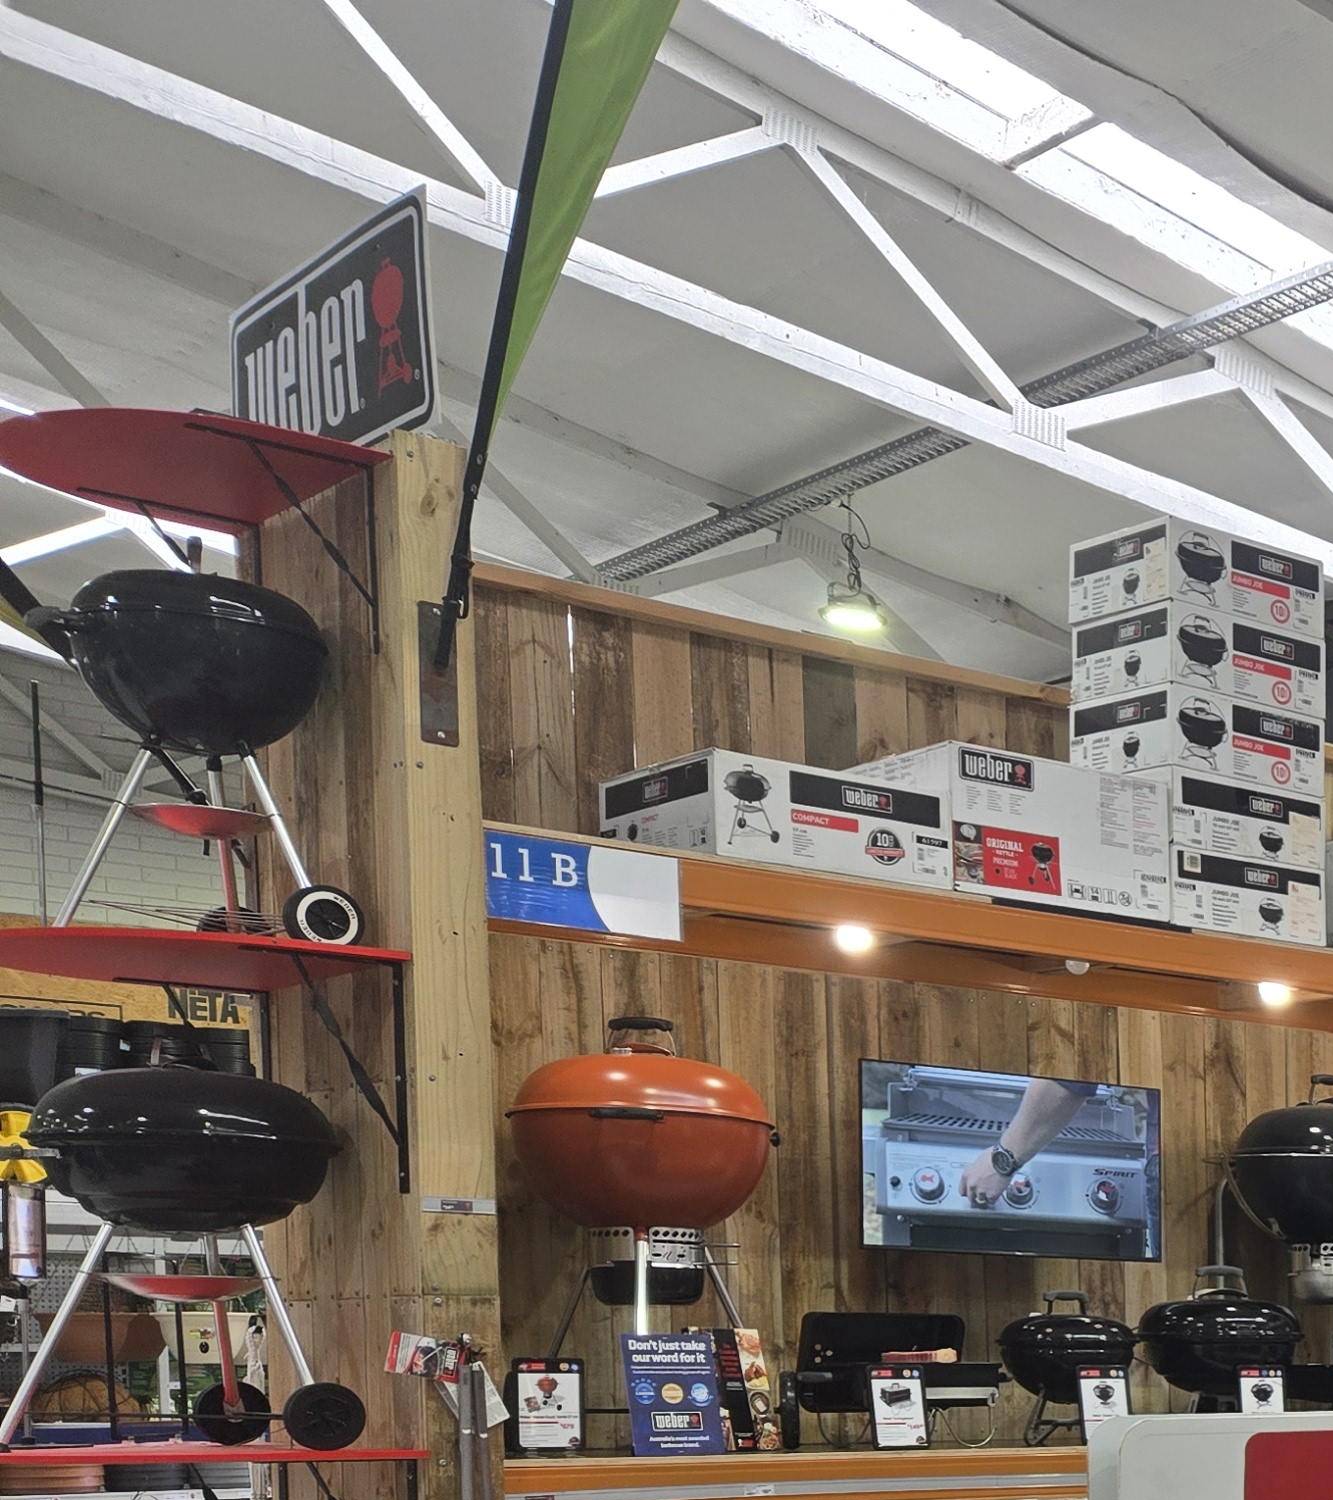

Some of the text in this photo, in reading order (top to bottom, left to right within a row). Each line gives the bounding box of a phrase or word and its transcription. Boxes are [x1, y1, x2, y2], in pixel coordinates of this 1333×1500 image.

[245, 279, 366, 438] weber
[964, 750, 1013, 783] weber
[845, 787, 879, 809] weber
[792, 812, 830, 826] COMPACT
[986, 837, 1024, 853] ORIGINAL
[551, 853, 579, 888] B
[1094, 1168, 1139, 1180] SPIRIT
[628, 1340, 707, 1353] Don't just take
[632, 1353, 706, 1363] our word for it
[655, 1413, 690, 1429] weber
